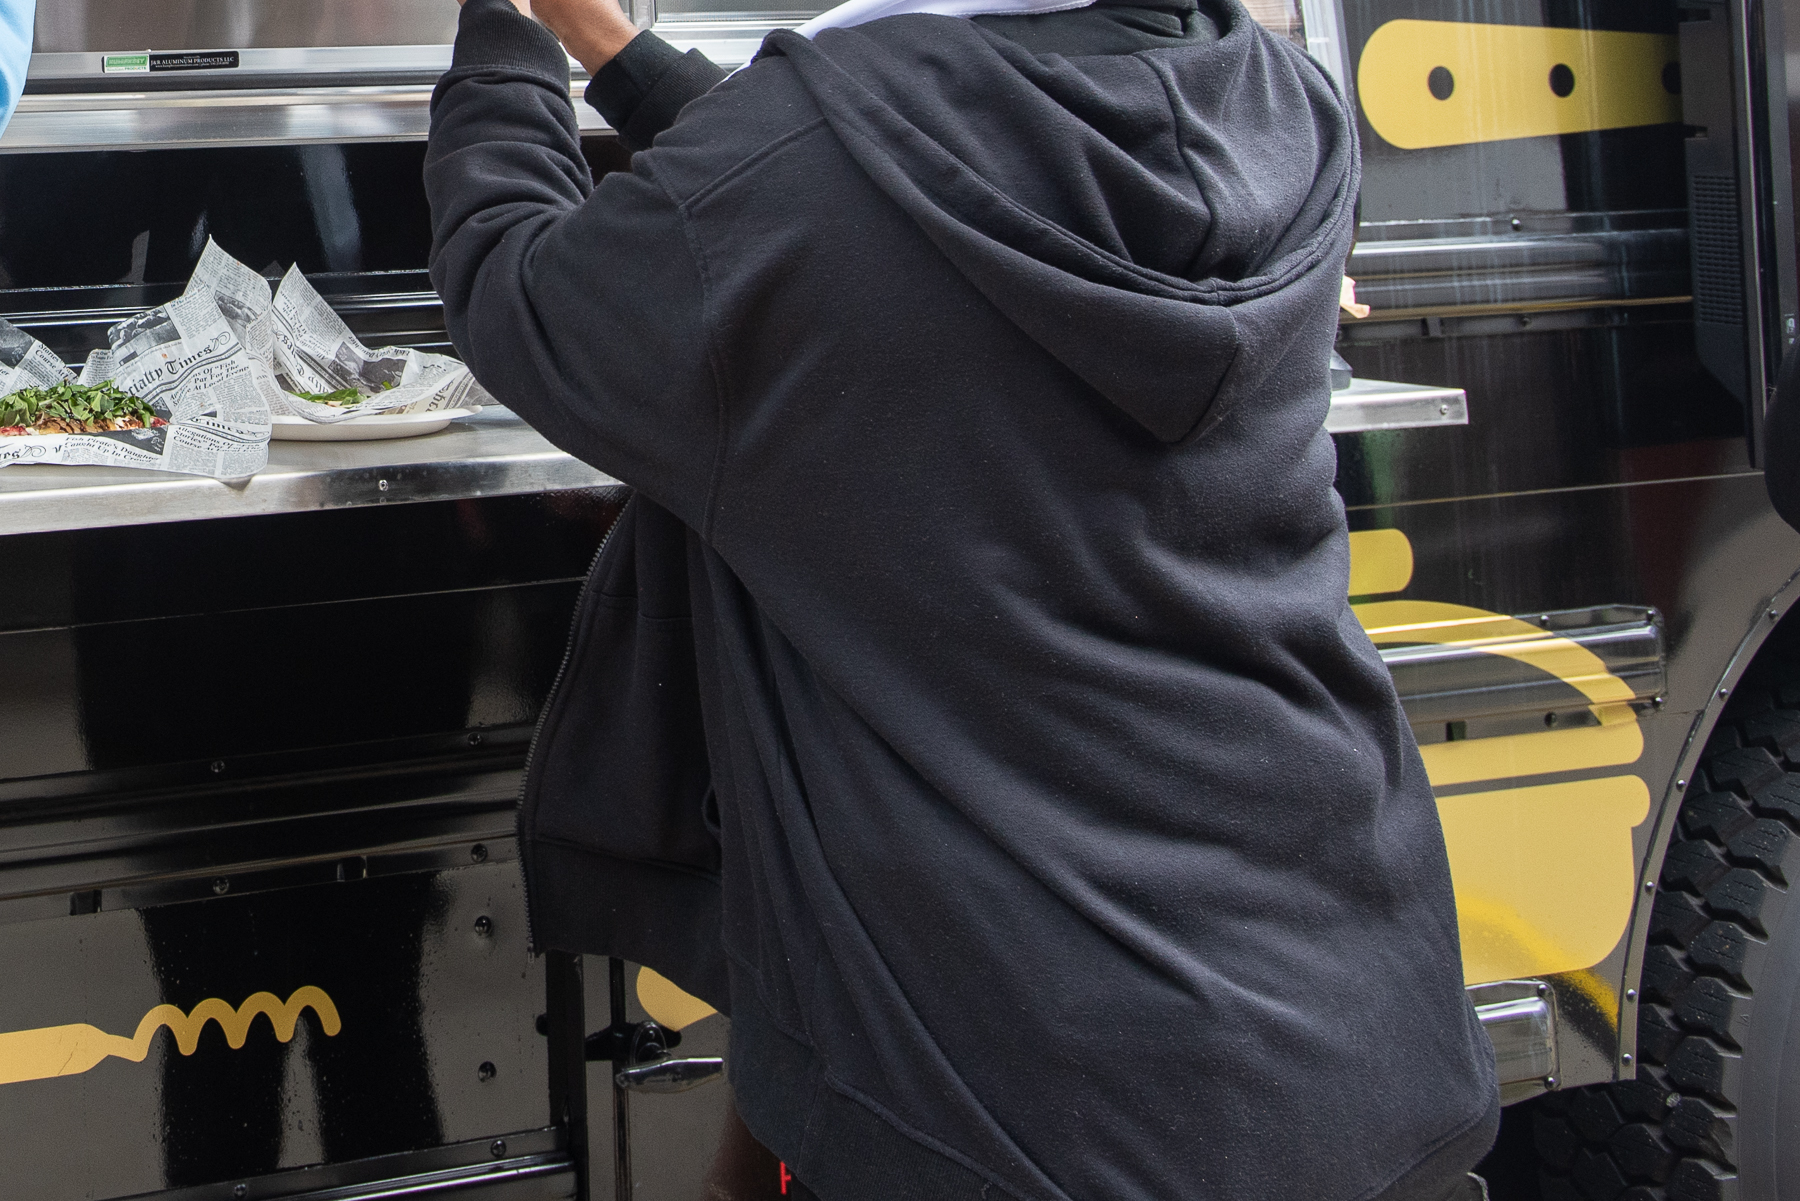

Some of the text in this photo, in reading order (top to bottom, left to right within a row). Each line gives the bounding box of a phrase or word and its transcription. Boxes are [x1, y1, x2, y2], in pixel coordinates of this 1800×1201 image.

[161, 58, 193, 66] ALUMINUM
[194, 56, 223, 65] PRODUCTS
[128, 367, 163, 396] cialty
[165, 344, 213, 375] Times
[194, 376, 208, 384] Par
